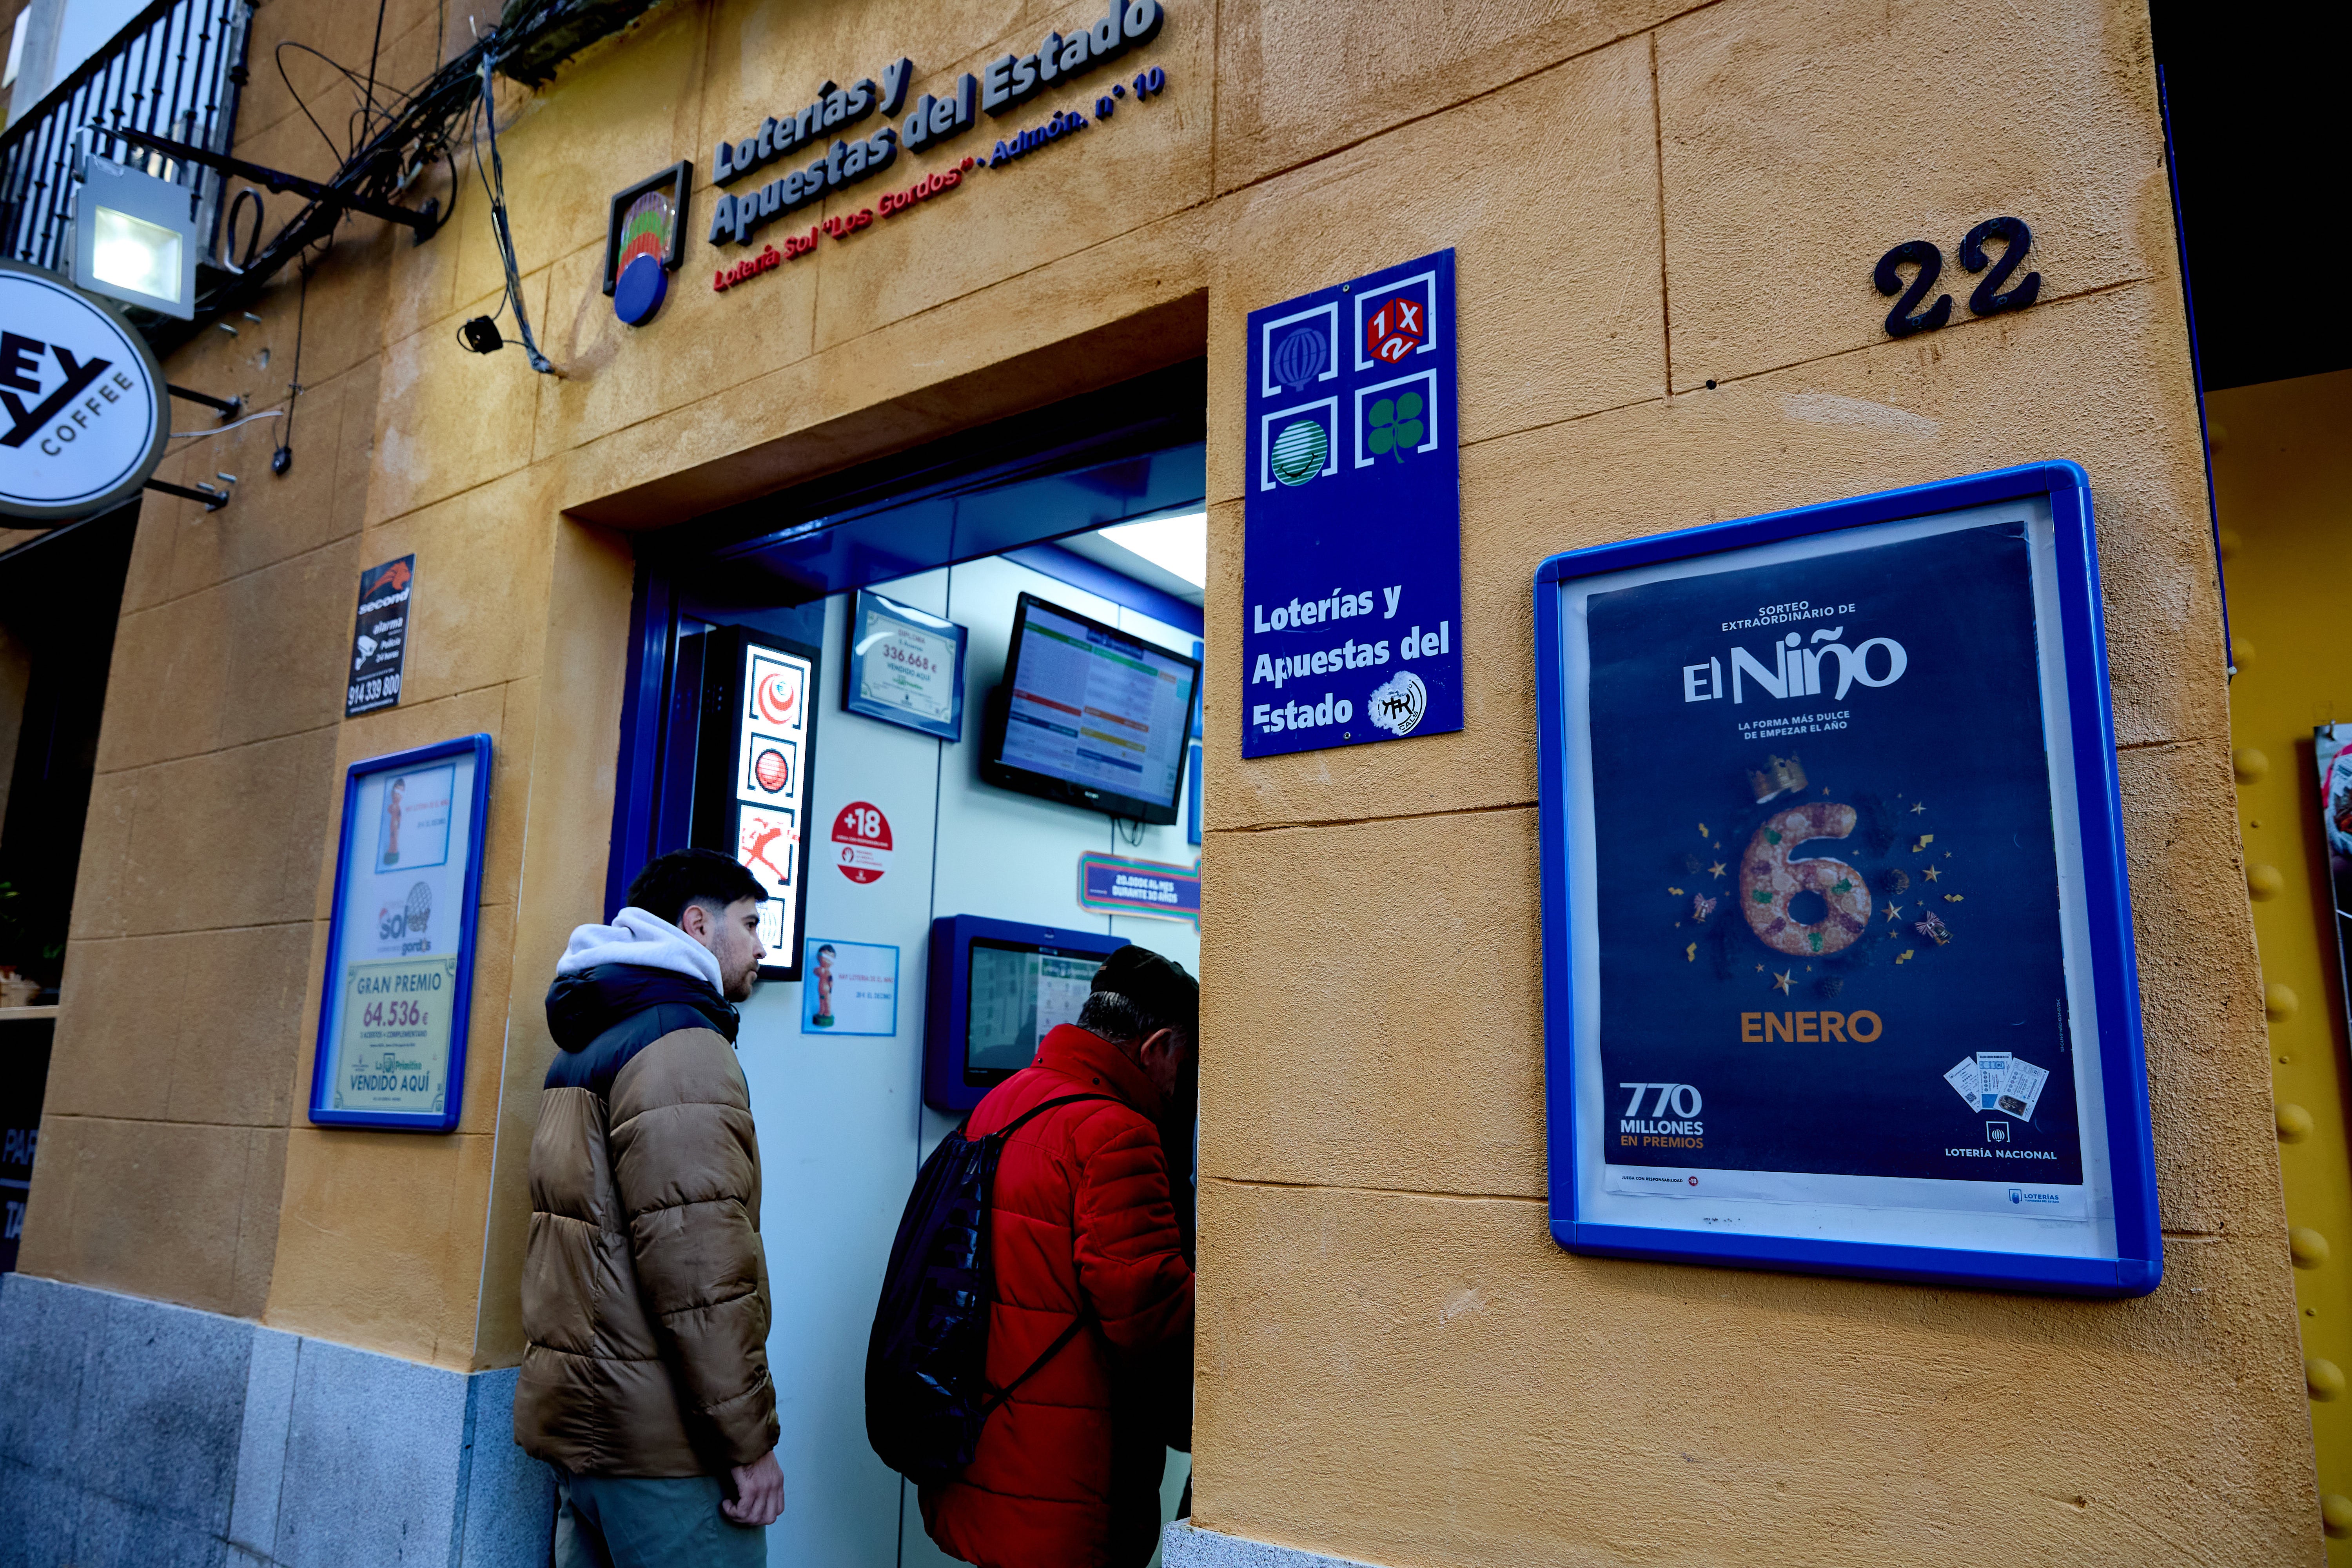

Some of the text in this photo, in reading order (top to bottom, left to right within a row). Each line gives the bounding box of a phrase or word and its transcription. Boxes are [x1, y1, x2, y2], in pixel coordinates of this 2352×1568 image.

[709, 0, 1164, 247] Apuestas del Estado
[712, 58, 913, 188] Loterías y
[784, 227, 818, 261] Sol
[1133, 65, 1165, 102] 10
[1874, 216, 2042, 337] 22
[41, 372, 134, 456] COFFEE
[1254, 585, 1402, 634] Loterías y
[1722, 603, 1856, 632] EXTRAORDINARIO DE
[1759, 601, 1809, 617] SORTEO
[883, 644, 929, 670] 336.668
[1252, 621, 1449, 689] Apuestas del
[1683, 626, 1907, 704] El Niño
[348, 682, 365, 706] 914
[365, 678, 382, 702] 339
[382, 673, 400, 697] 800
[1253, 693, 1353, 733] Estado
[1738, 710, 1850, 731] LA FORMA MÁS DULCE
[1744, 720, 1847, 740] DE EMPEZAR EL AÑO
[844, 808, 881, 838] +18
[1740, 802, 1871, 956] 6
[358, 973, 442, 995] GRAN PREMIO
[363, 1000, 428, 1027] 64.536 €
[1741, 1010, 1882, 1043] ENERO
[350, 1070, 430, 1093] VENDIDO AQUÍ
[1620, 1082, 1702, 1118] 770
[1621, 1120, 1704, 1135] MILLONES
[1621, 1136, 1704, 1149] EN PREMIOS
[1945, 1147, 2057, 1160] LOTERÍA NACIONAL
